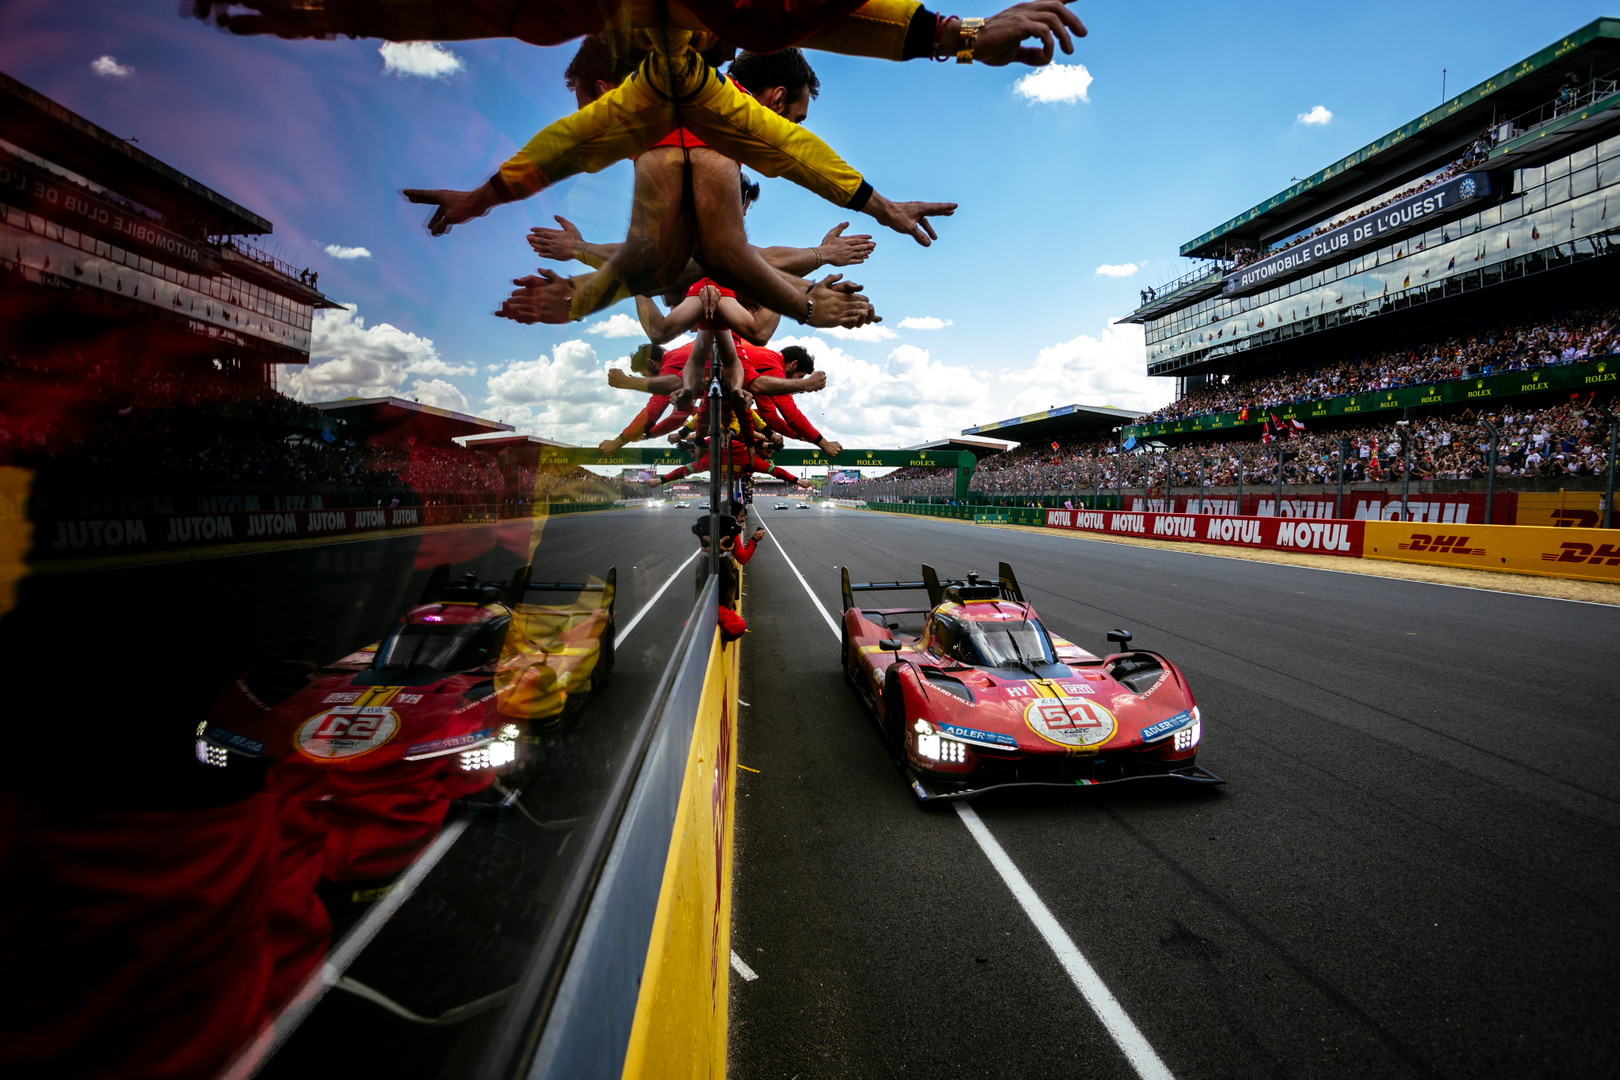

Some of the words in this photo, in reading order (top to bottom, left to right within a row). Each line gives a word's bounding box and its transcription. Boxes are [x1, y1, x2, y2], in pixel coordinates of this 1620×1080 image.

[1555, 42, 1575, 56] ROLEX
[1516, 65, 1533, 77] ROLEX
[1480, 85, 1496, 96] ROLEX
[1241, 249, 1311, 287] AUTOMOBILE
[1314, 233, 1349, 257] CLUB
[1353, 227, 1373, 242] DE
[1377, 191, 1446, 233] L'OUEST
[1585, 372, 1617, 383] ROLEX
[1468, 389, 1491, 398] ROLEX
[1521, 382, 1549, 391] ROLEX
[1421, 395, 1442, 403] ROLEX
[1047, 511, 1071, 526] MOTUL
[1076, 512, 1104, 529] MOTUL
[1111, 514, 1145, 533] MOTUL
[1153, 516, 1196, 537] MOTUL
[1207, 518, 1262, 543] MOTUL
[1276, 521, 1351, 551] MOTUL
[1409, 533, 1473, 554] DHL
[1557, 542, 1620, 567] DH
[920, 679, 951, 697] RICHARD
[951, 694, 975, 708] MILLE
[1006, 686, 1029, 697] HY
[1042, 706, 1098, 726] 51
[944, 726, 986, 739] ADLER
[1143, 721, 1174, 737] ADLER
